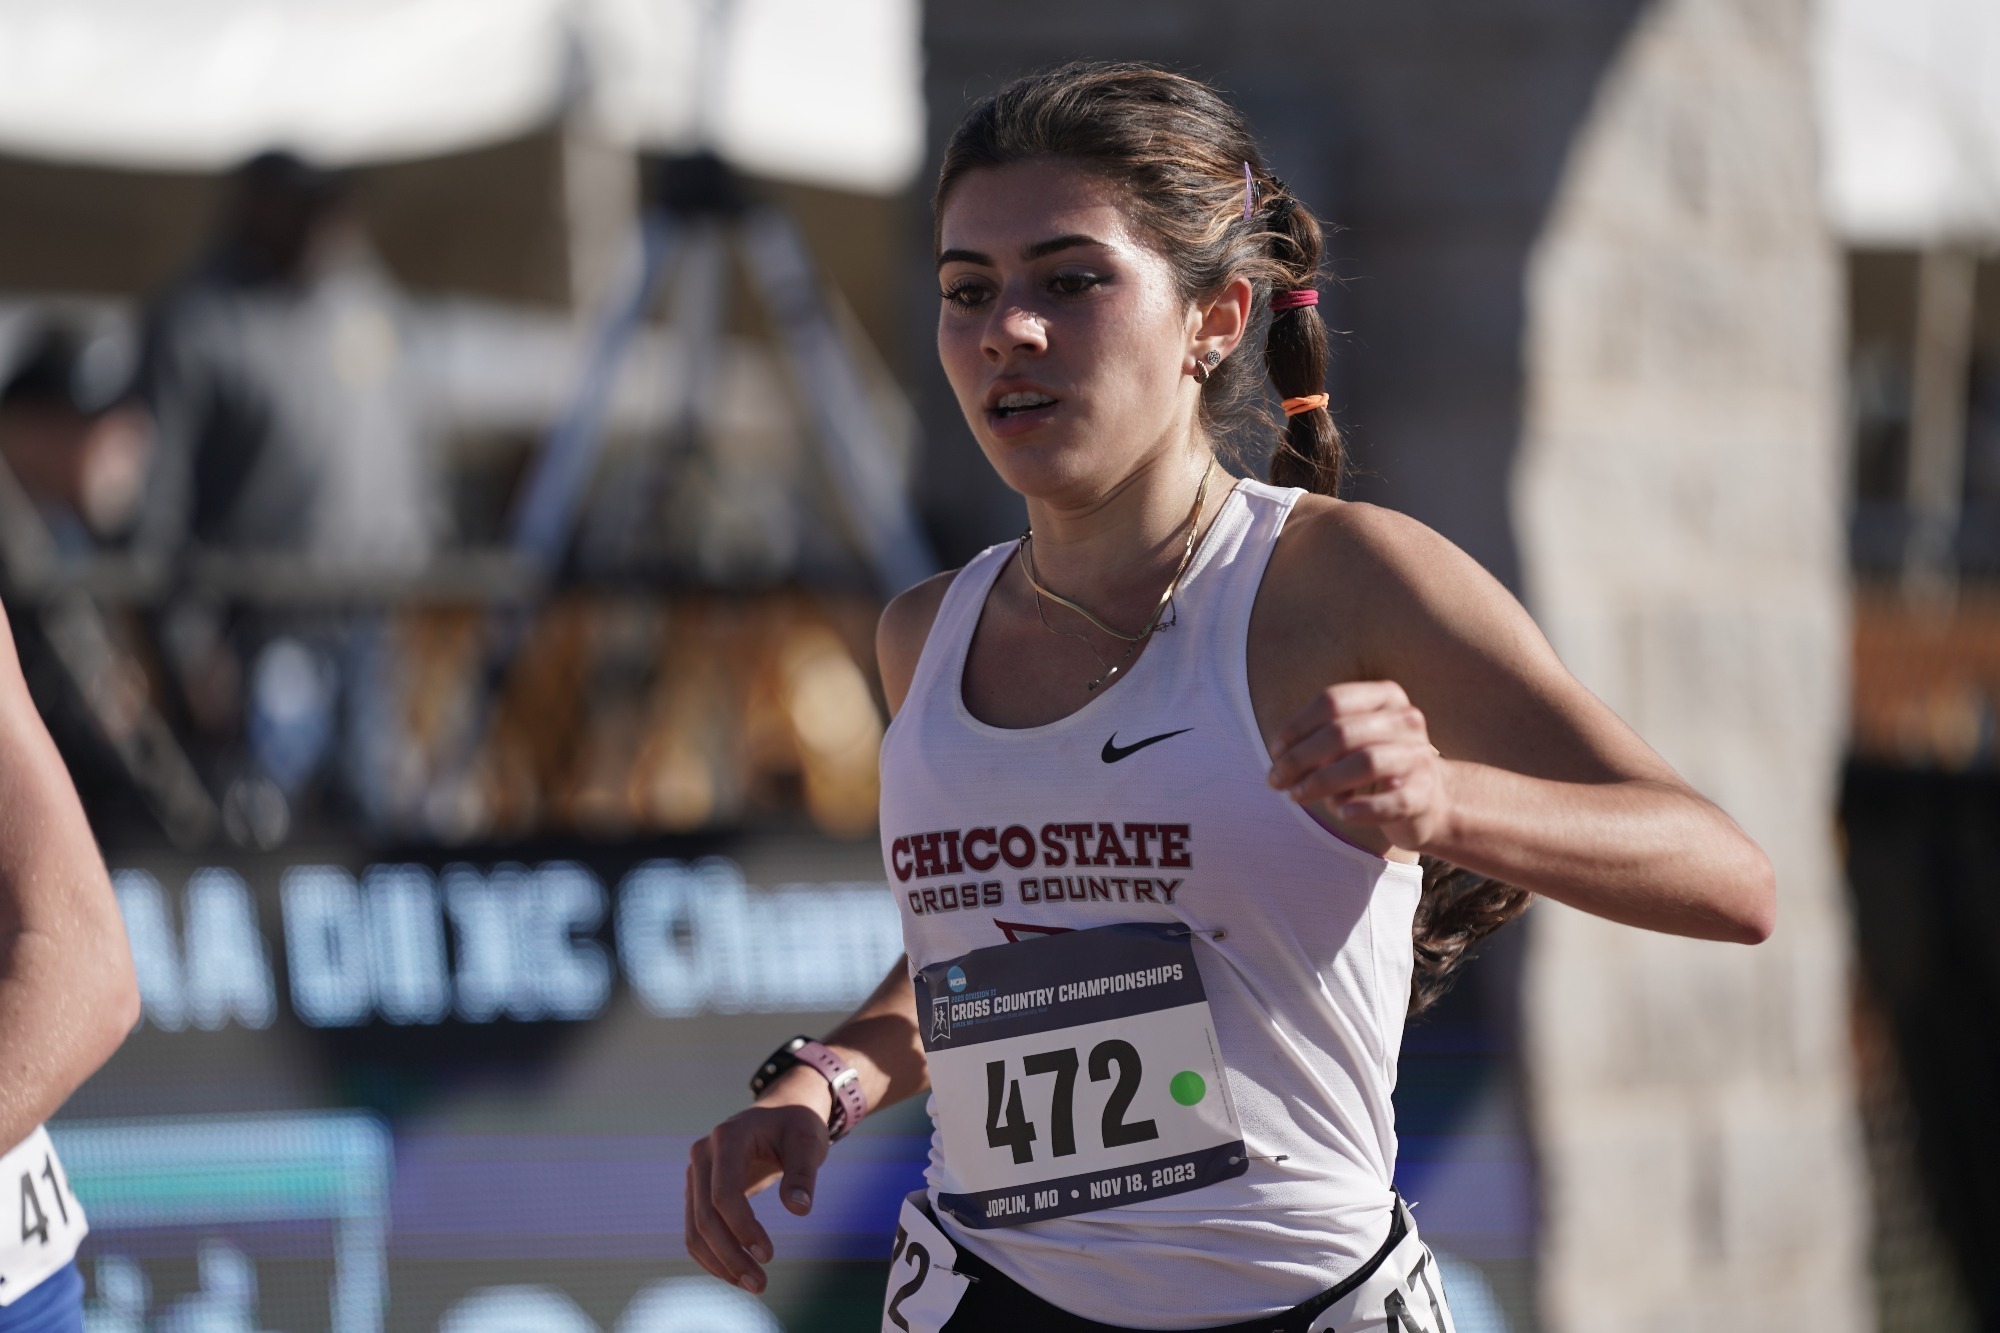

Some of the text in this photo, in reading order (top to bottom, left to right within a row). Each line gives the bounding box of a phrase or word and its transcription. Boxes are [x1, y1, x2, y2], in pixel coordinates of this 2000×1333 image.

[892, 823, 1193, 882] CHICO STATE
[909, 876, 1183, 915] CROSS COUNTRY
[950, 977, 967, 987] NCAA
[951, 999, 991, 1022] CROSS
[993, 987, 1055, 1014] COUNTRY
[1058, 964, 1183, 1002] CHAMPIONSHIPS
[986, 1039, 1159, 1164] 472
[20, 1153, 74, 1246] 41
[986, 1162, 1196, 1218] JOPLIN, MO NOV 18, 2023
